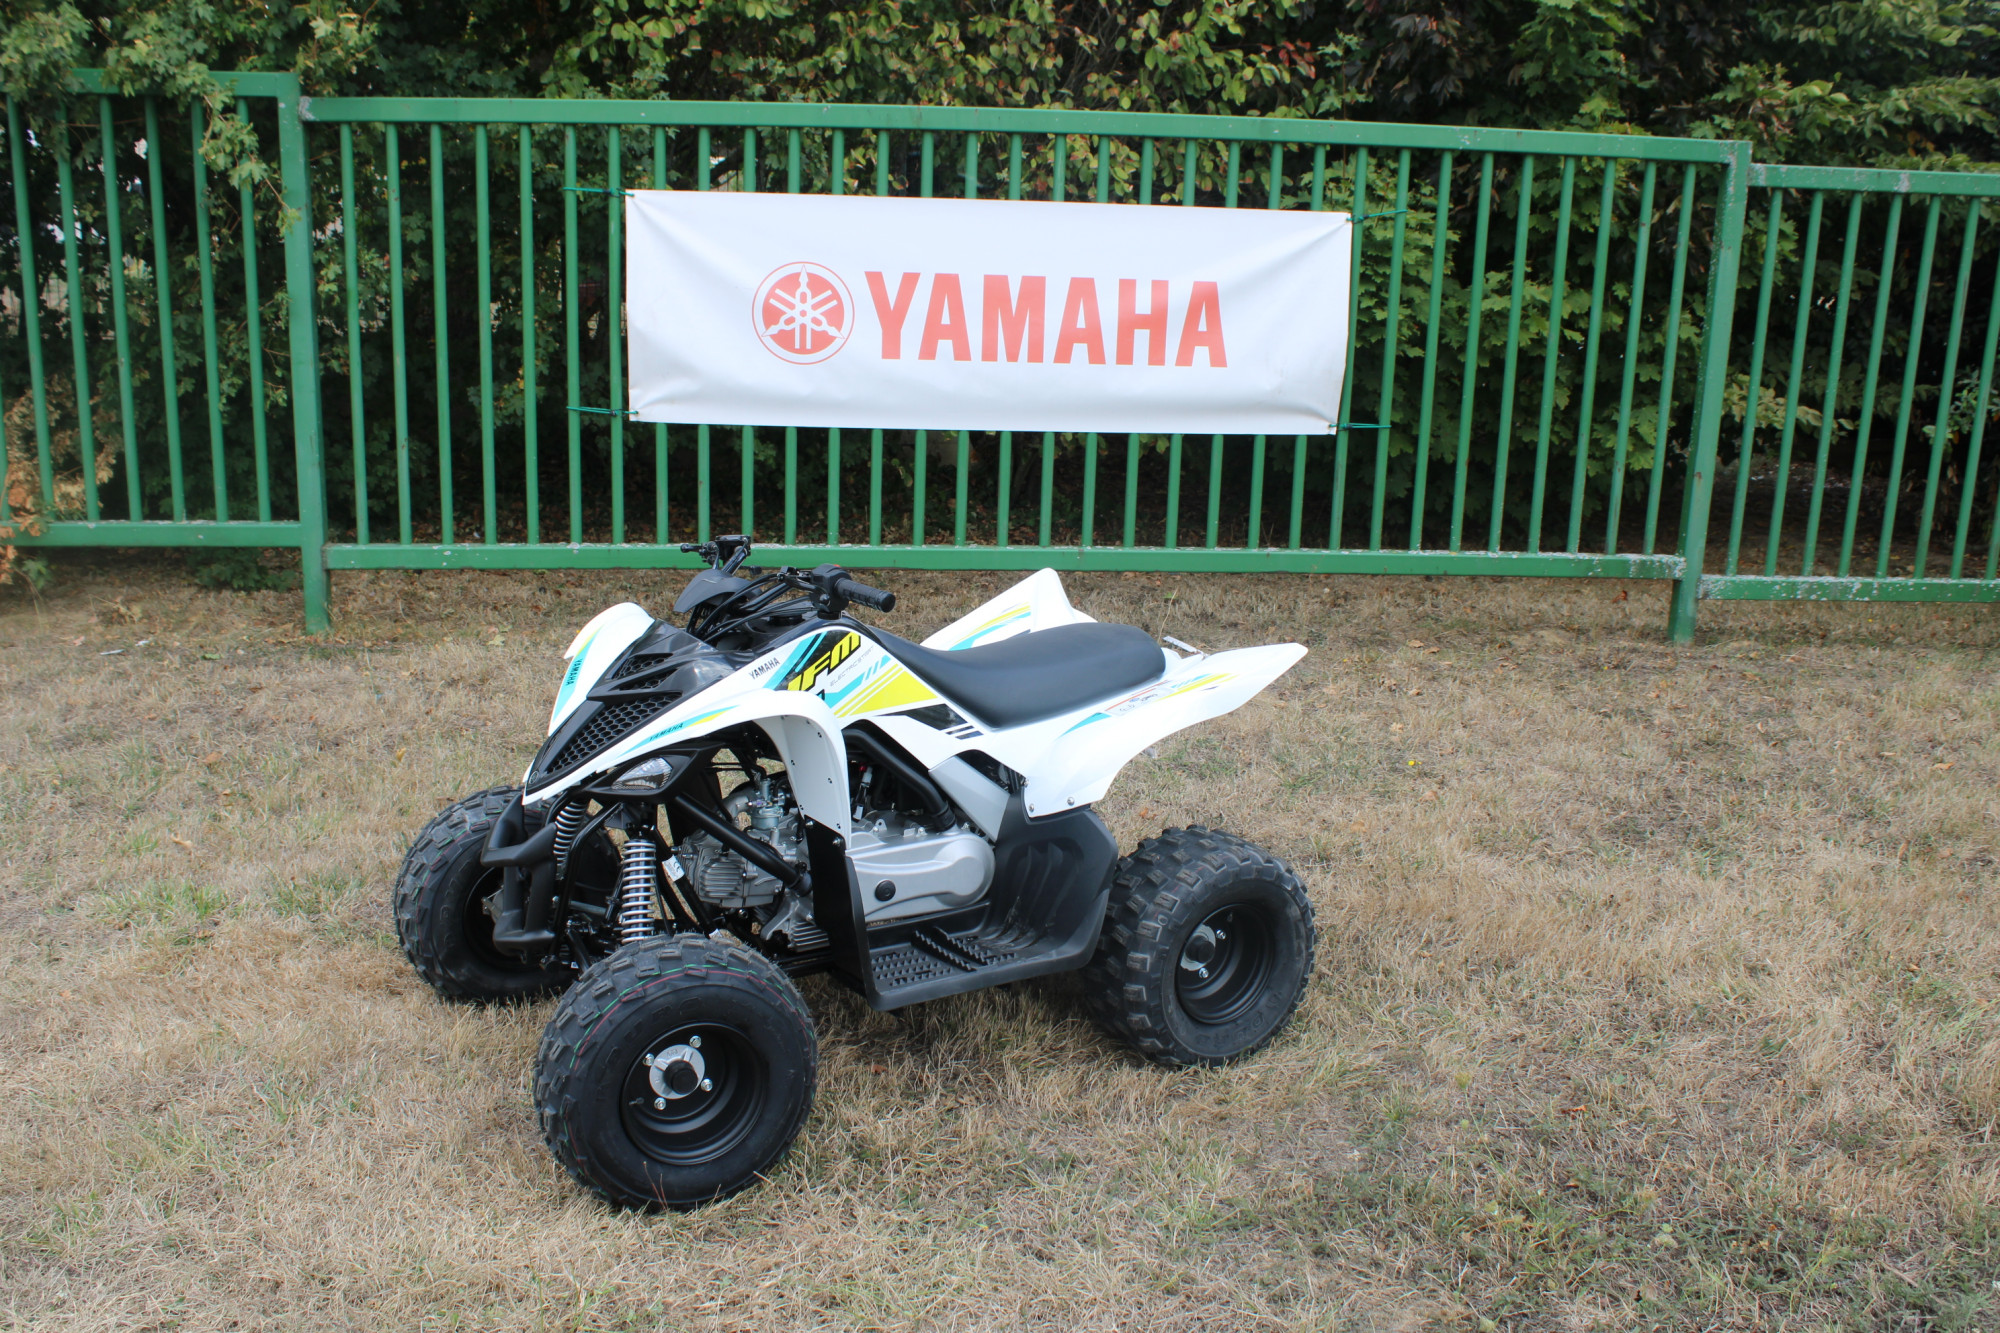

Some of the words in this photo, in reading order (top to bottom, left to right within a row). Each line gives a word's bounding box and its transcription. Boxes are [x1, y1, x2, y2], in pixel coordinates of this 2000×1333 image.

[864, 270, 1228, 367] YAMAHA
[566, 658, 583, 686] YAMAHA
[748, 657, 780, 679] YAMAHA
[650, 722, 684, 741] YAMAHA
